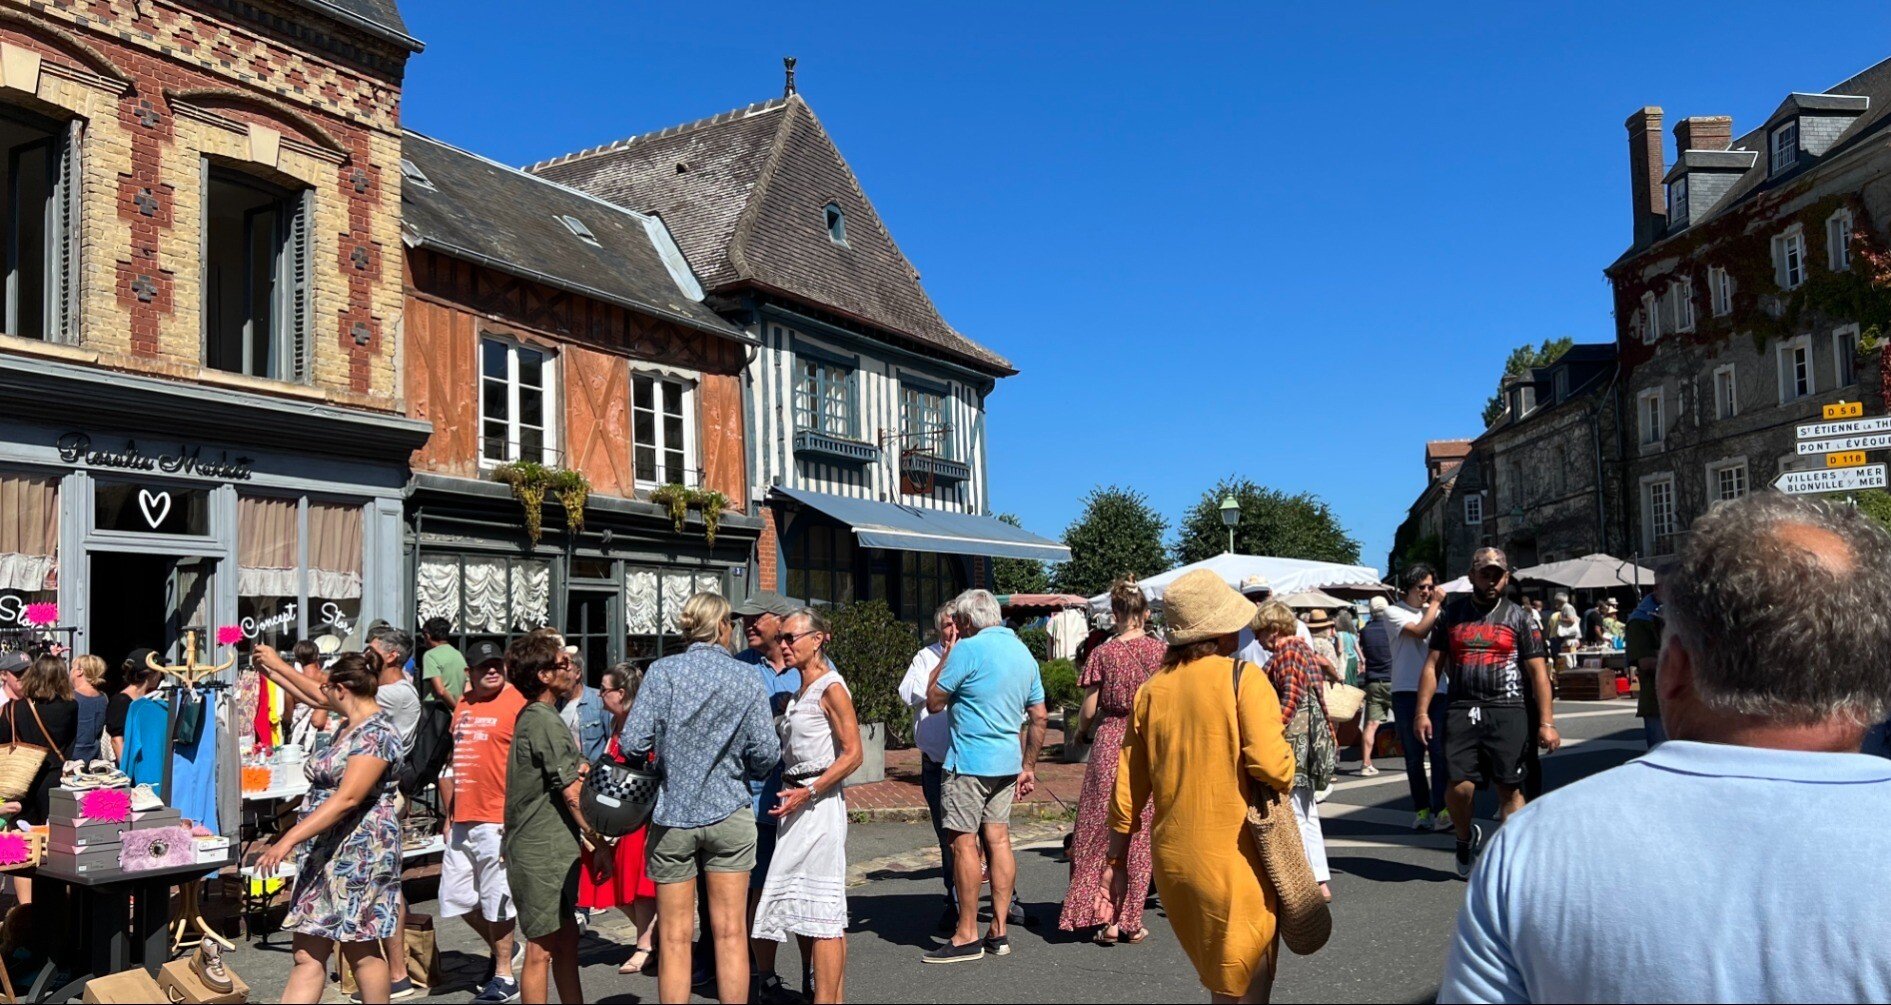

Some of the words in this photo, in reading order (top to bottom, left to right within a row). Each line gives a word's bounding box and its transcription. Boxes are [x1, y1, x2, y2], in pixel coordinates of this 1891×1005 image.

[1828, 408, 1834, 416] D
[1840, 406, 1857, 415] 58
[1814, 423, 1860, 435] ÉTIENNE
[1800, 442, 1830, 452] PONT
[1830, 456, 1837, 464] D
[1843, 454, 1862, 463] 118
[1787, 472, 1836, 482] VILLERS
[1856, 467, 1882, 477] MER
[1787, 480, 1844, 491] BLONVILLE
[1859, 477, 1883, 486] MER
[241, 602, 297, 638] Concept
[321, 602, 354, 636] Store
